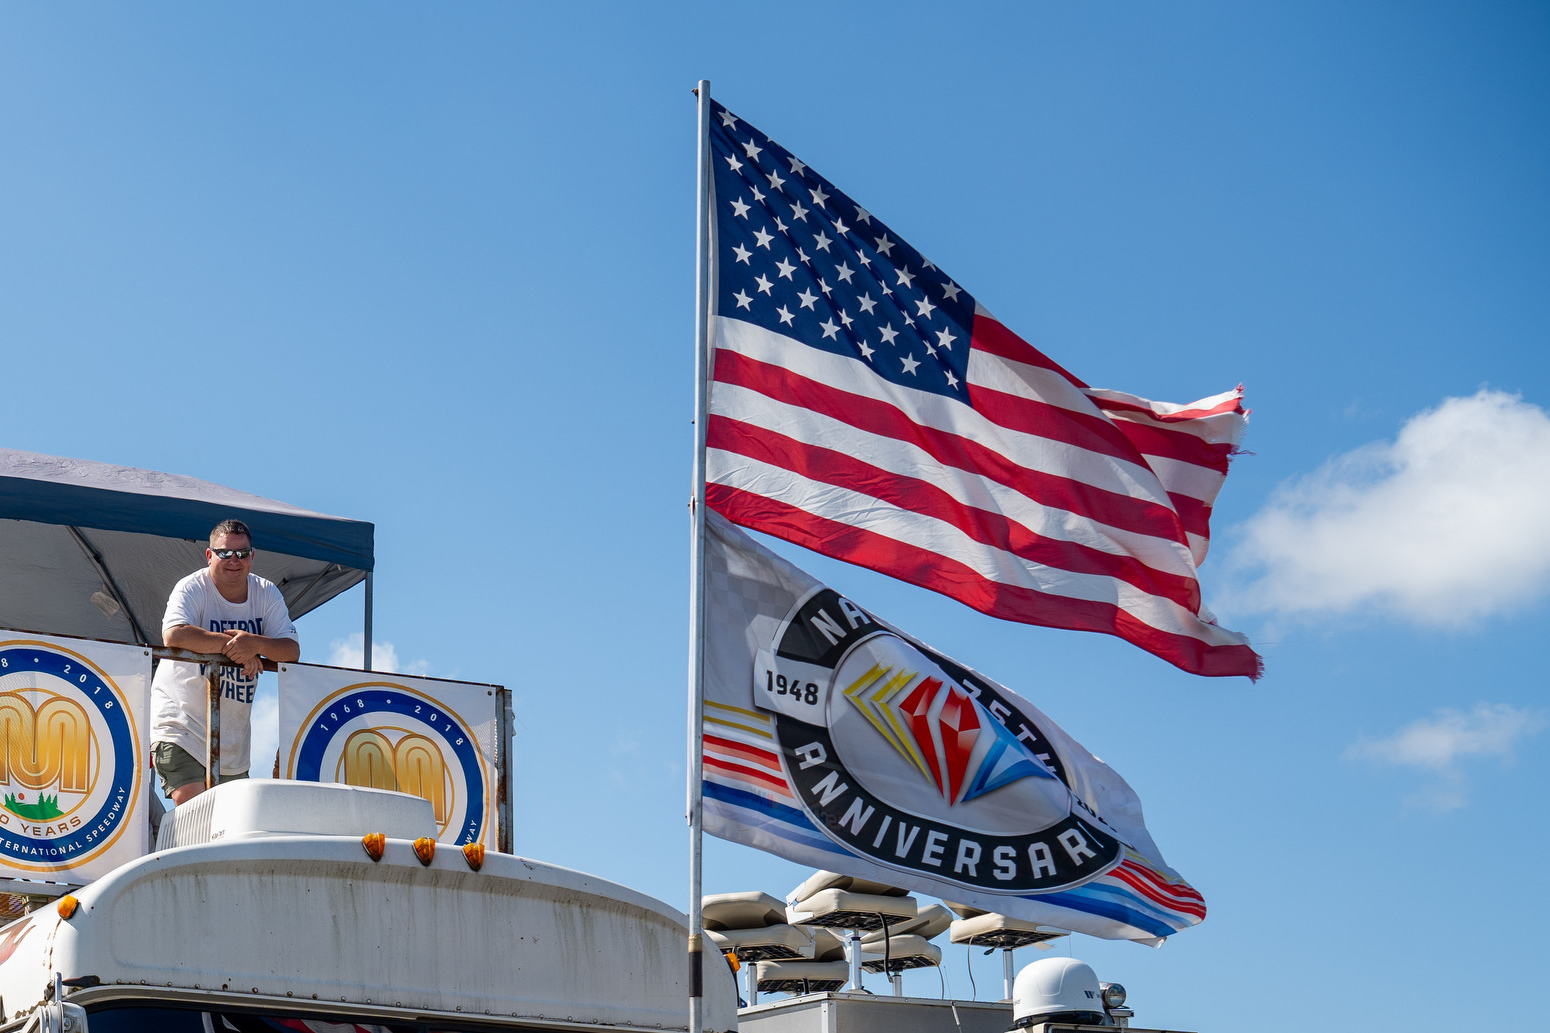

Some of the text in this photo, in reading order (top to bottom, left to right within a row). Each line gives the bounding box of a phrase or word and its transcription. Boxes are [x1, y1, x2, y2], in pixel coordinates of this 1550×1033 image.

[63, 664, 113, 710] 2018
[766, 670, 819, 705] 1948
[320, 699, 464, 746] 1968 2018
[21, 815, 82, 837] YEARS
[86, 786, 127, 843] SPEEDWAY
[794, 740, 1104, 881] ANNIVERSAR
